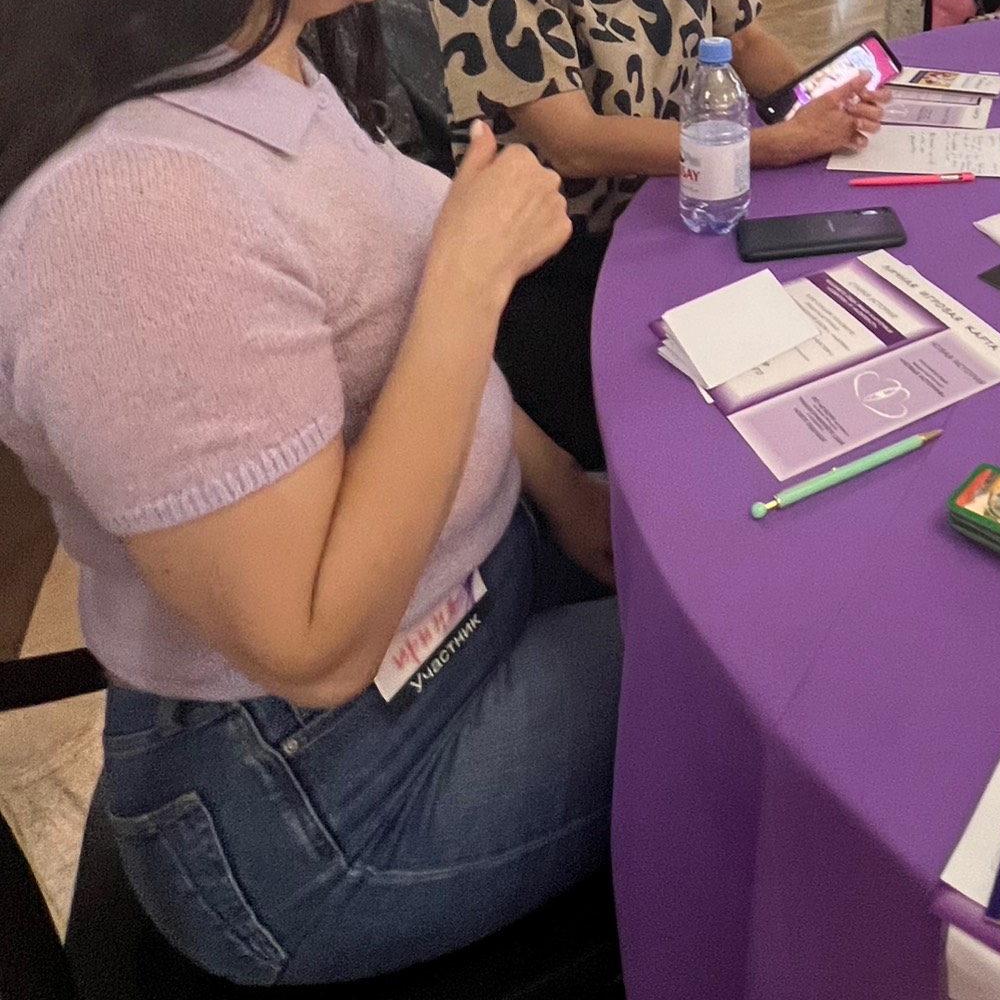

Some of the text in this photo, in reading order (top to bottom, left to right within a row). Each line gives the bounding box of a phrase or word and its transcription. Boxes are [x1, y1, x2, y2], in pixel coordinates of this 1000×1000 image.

[920, 290, 963, 323] ИГРОВАЯ
[965, 324, 999, 351] КАРТА
[410, 613, 482, 693] Участник
